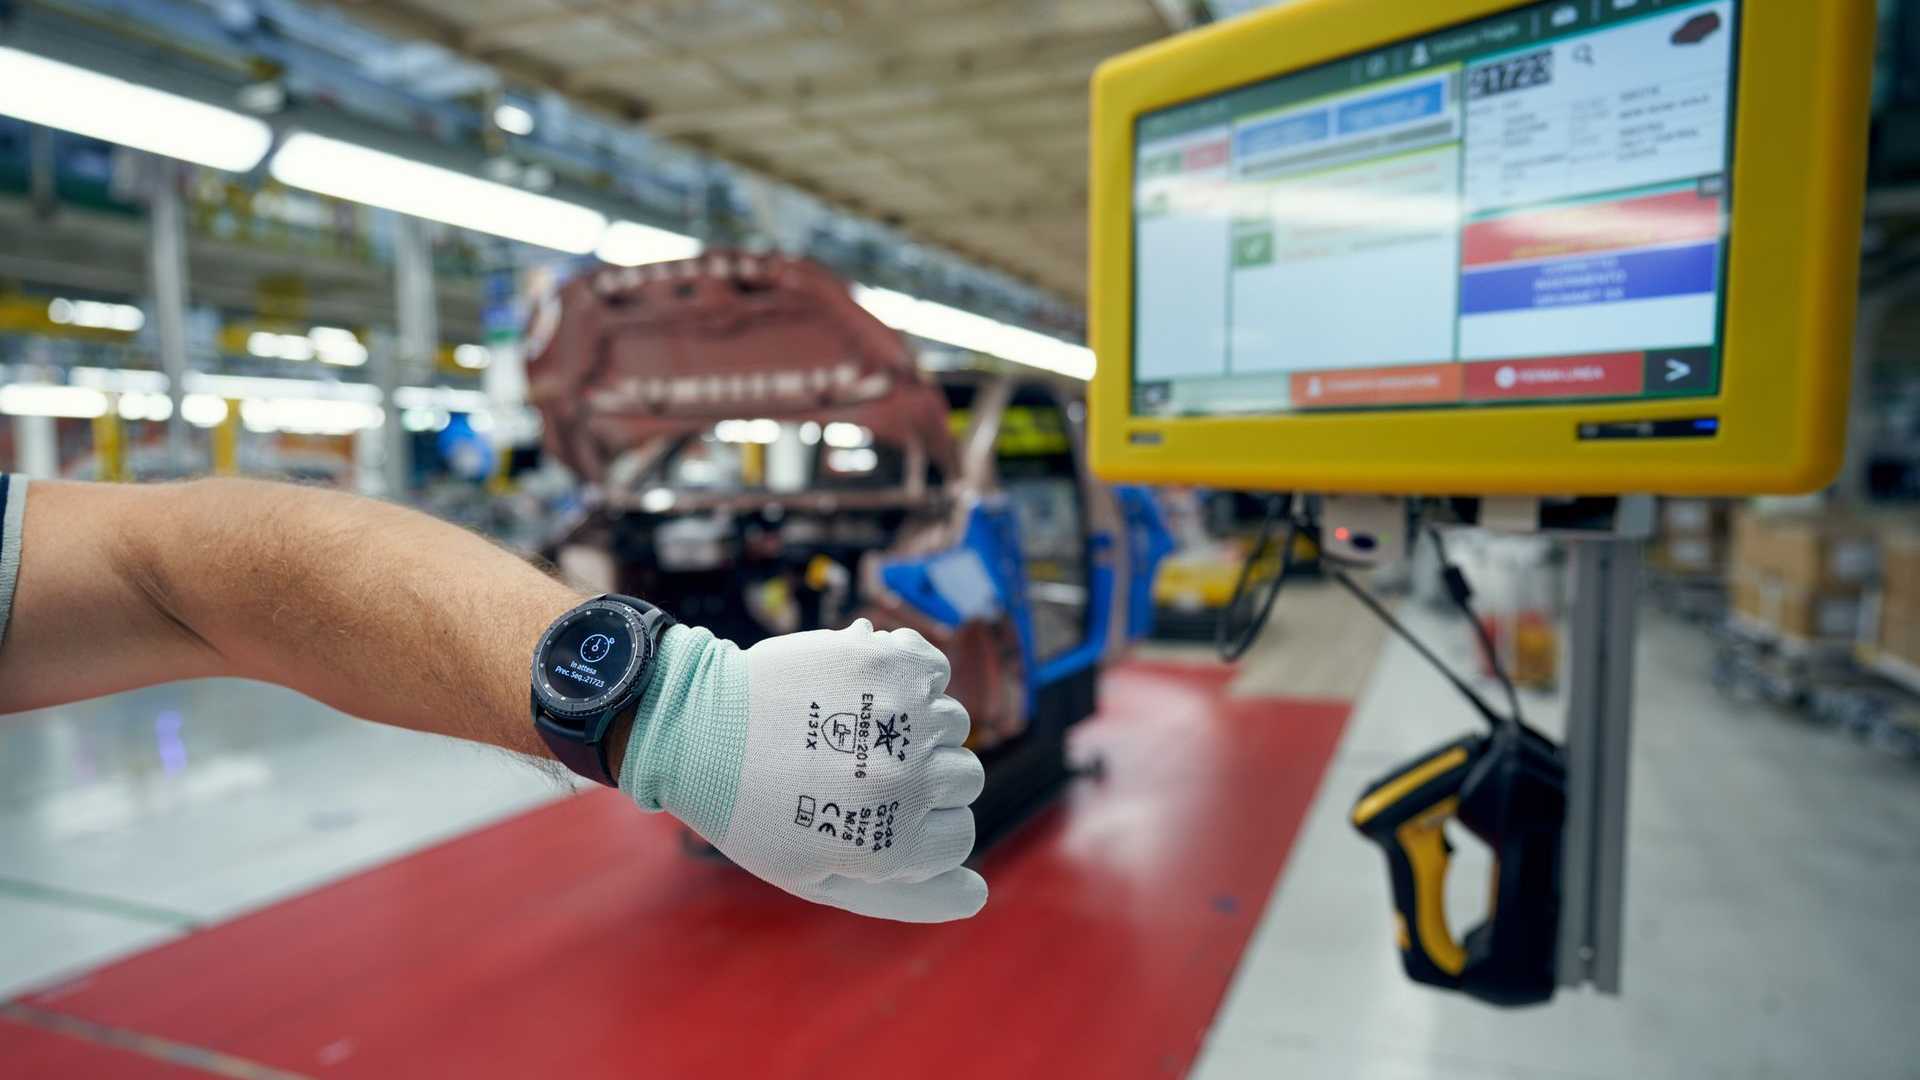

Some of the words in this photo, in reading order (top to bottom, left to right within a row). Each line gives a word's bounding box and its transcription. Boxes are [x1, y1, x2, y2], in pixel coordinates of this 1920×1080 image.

[570, 660, 578, 668] In
[577, 664, 597, 675] attesa
[806, 702, 820, 750] 4131X
[898, 713, 910, 762] STAR
[842, 811, 857, 841] M/8
[856, 808, 871, 846] Size
